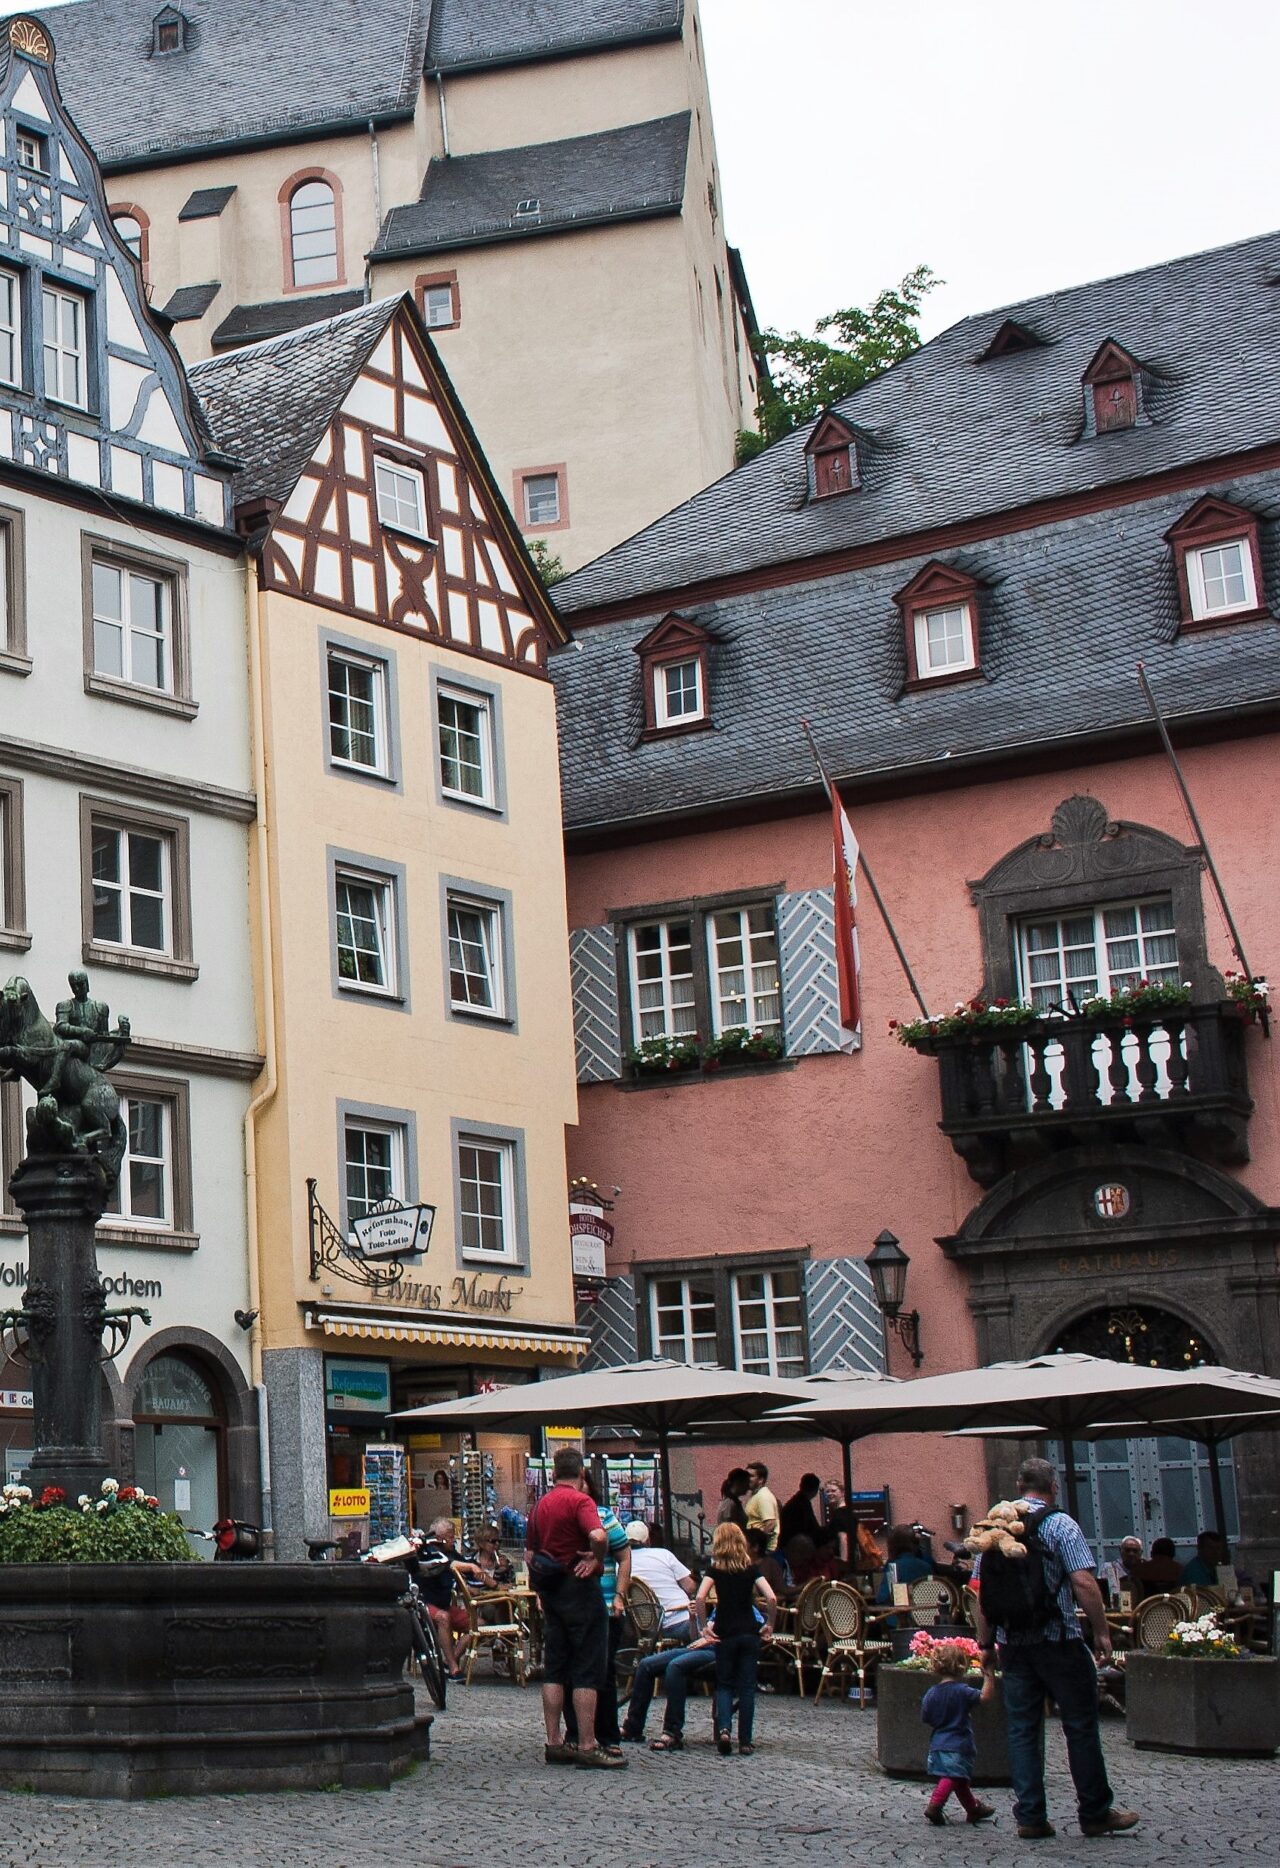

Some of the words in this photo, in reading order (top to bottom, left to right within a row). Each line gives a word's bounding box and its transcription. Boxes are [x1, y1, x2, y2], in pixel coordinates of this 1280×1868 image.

[361, 1215, 413, 1238] Reformhaus
[579, 1214, 596, 1224] HOTEL
[368, 1236, 409, 1250] Toto-Lotto
[1059, 1249, 1178, 1274] RATHAUS
[451, 1272, 523, 1312] Markt
[333, 1376, 383, 1393] Reformhaus
[342, 1495, 367, 1506] LOTTO
